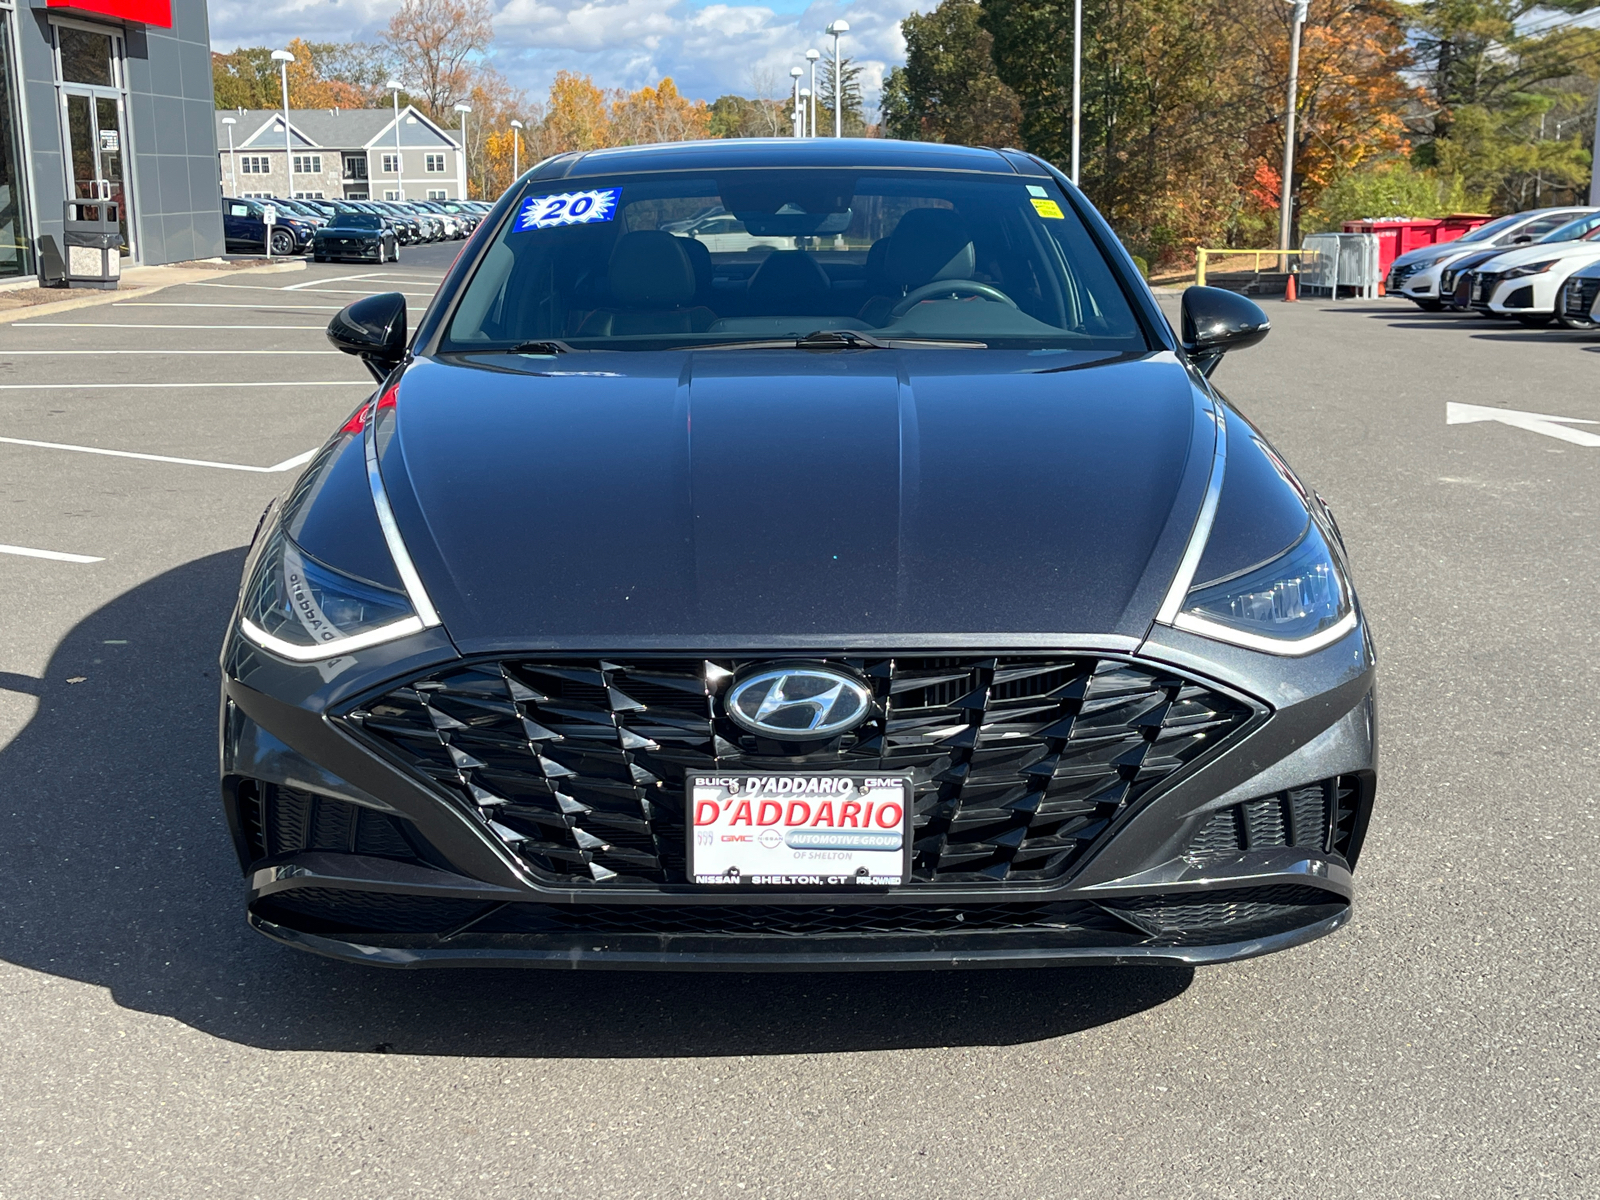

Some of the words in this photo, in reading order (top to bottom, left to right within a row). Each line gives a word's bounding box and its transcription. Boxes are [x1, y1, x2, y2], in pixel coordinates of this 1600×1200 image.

[540, 196, 593, 220] 20
[695, 778, 740, 786] BUICK
[745, 777, 854, 794] D'ADDARIO
[864, 779, 903, 787] GMC
[694, 799, 903, 829] D'ADDARIO
[720, 835, 754, 843] GMC
[791, 834, 860, 845] AUTOMOTIVE
[861, 836, 899, 846] GROUP
[793, 851, 807, 860] OF
[808, 851, 853, 861] SHELTON
[696, 875, 741, 885] NISSAN
[751, 875, 824, 886] SHELTON,
[827, 876, 848, 885] CT
